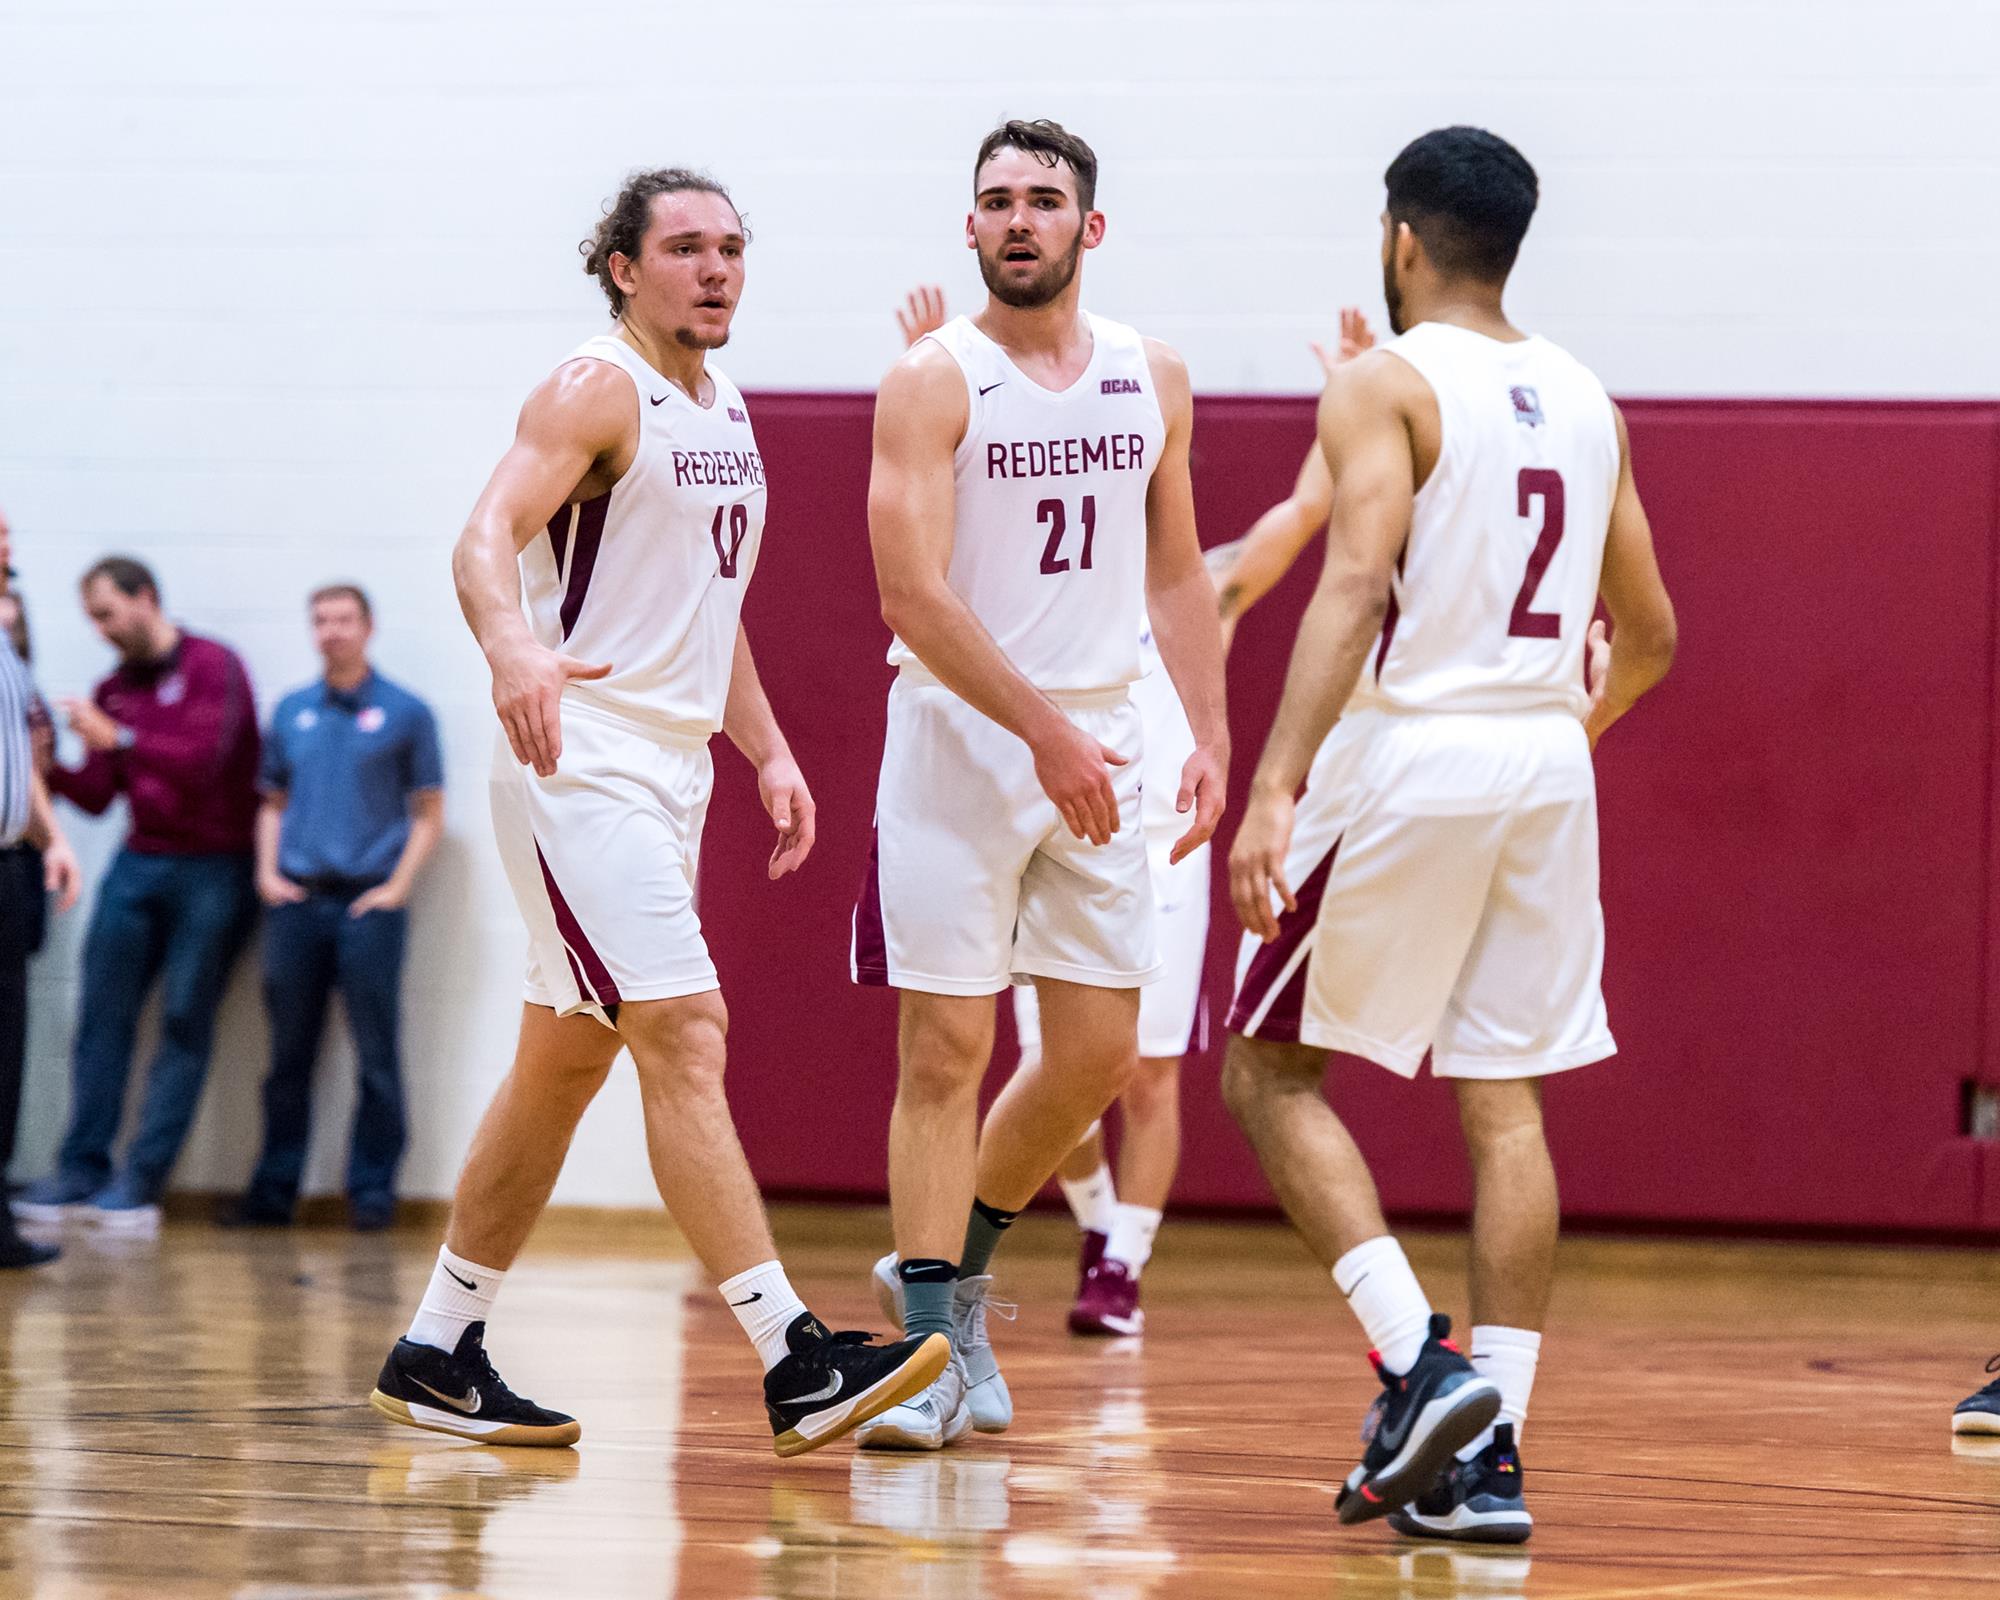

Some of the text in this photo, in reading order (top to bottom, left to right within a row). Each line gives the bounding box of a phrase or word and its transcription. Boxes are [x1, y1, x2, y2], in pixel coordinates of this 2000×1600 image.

[1101, 379, 1142, 394] OCAA
[987, 434, 1145, 479] REDEEMER
[712, 503, 748, 579] 10
[1037, 495, 1096, 575] 21
[1508, 467, 1565, 639] 2
